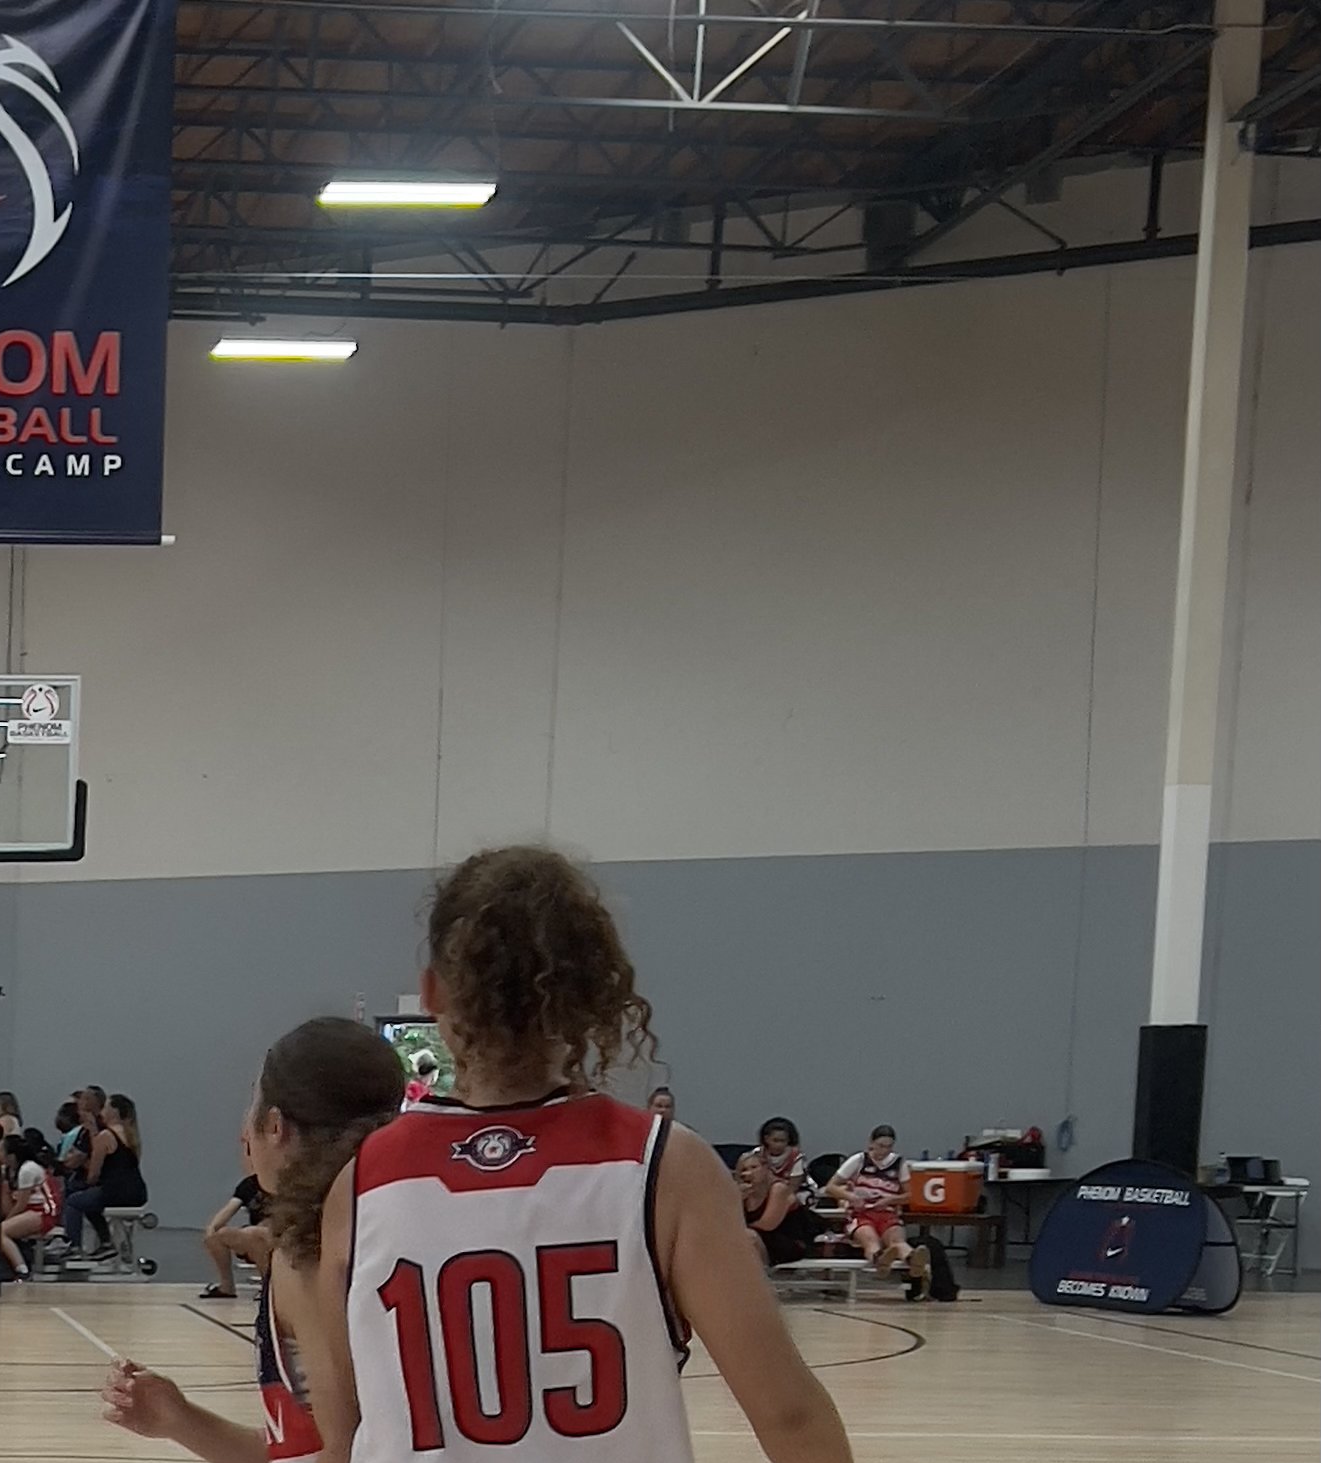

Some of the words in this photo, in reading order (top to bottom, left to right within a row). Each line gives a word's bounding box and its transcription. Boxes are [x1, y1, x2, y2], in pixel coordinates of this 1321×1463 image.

[6, 453, 123, 476] CAMP
[923, 1177, 946, 1204] G
[1123, 1187, 1191, 1207] BASKETBALL
[376, 1239, 627, 1452] 105
